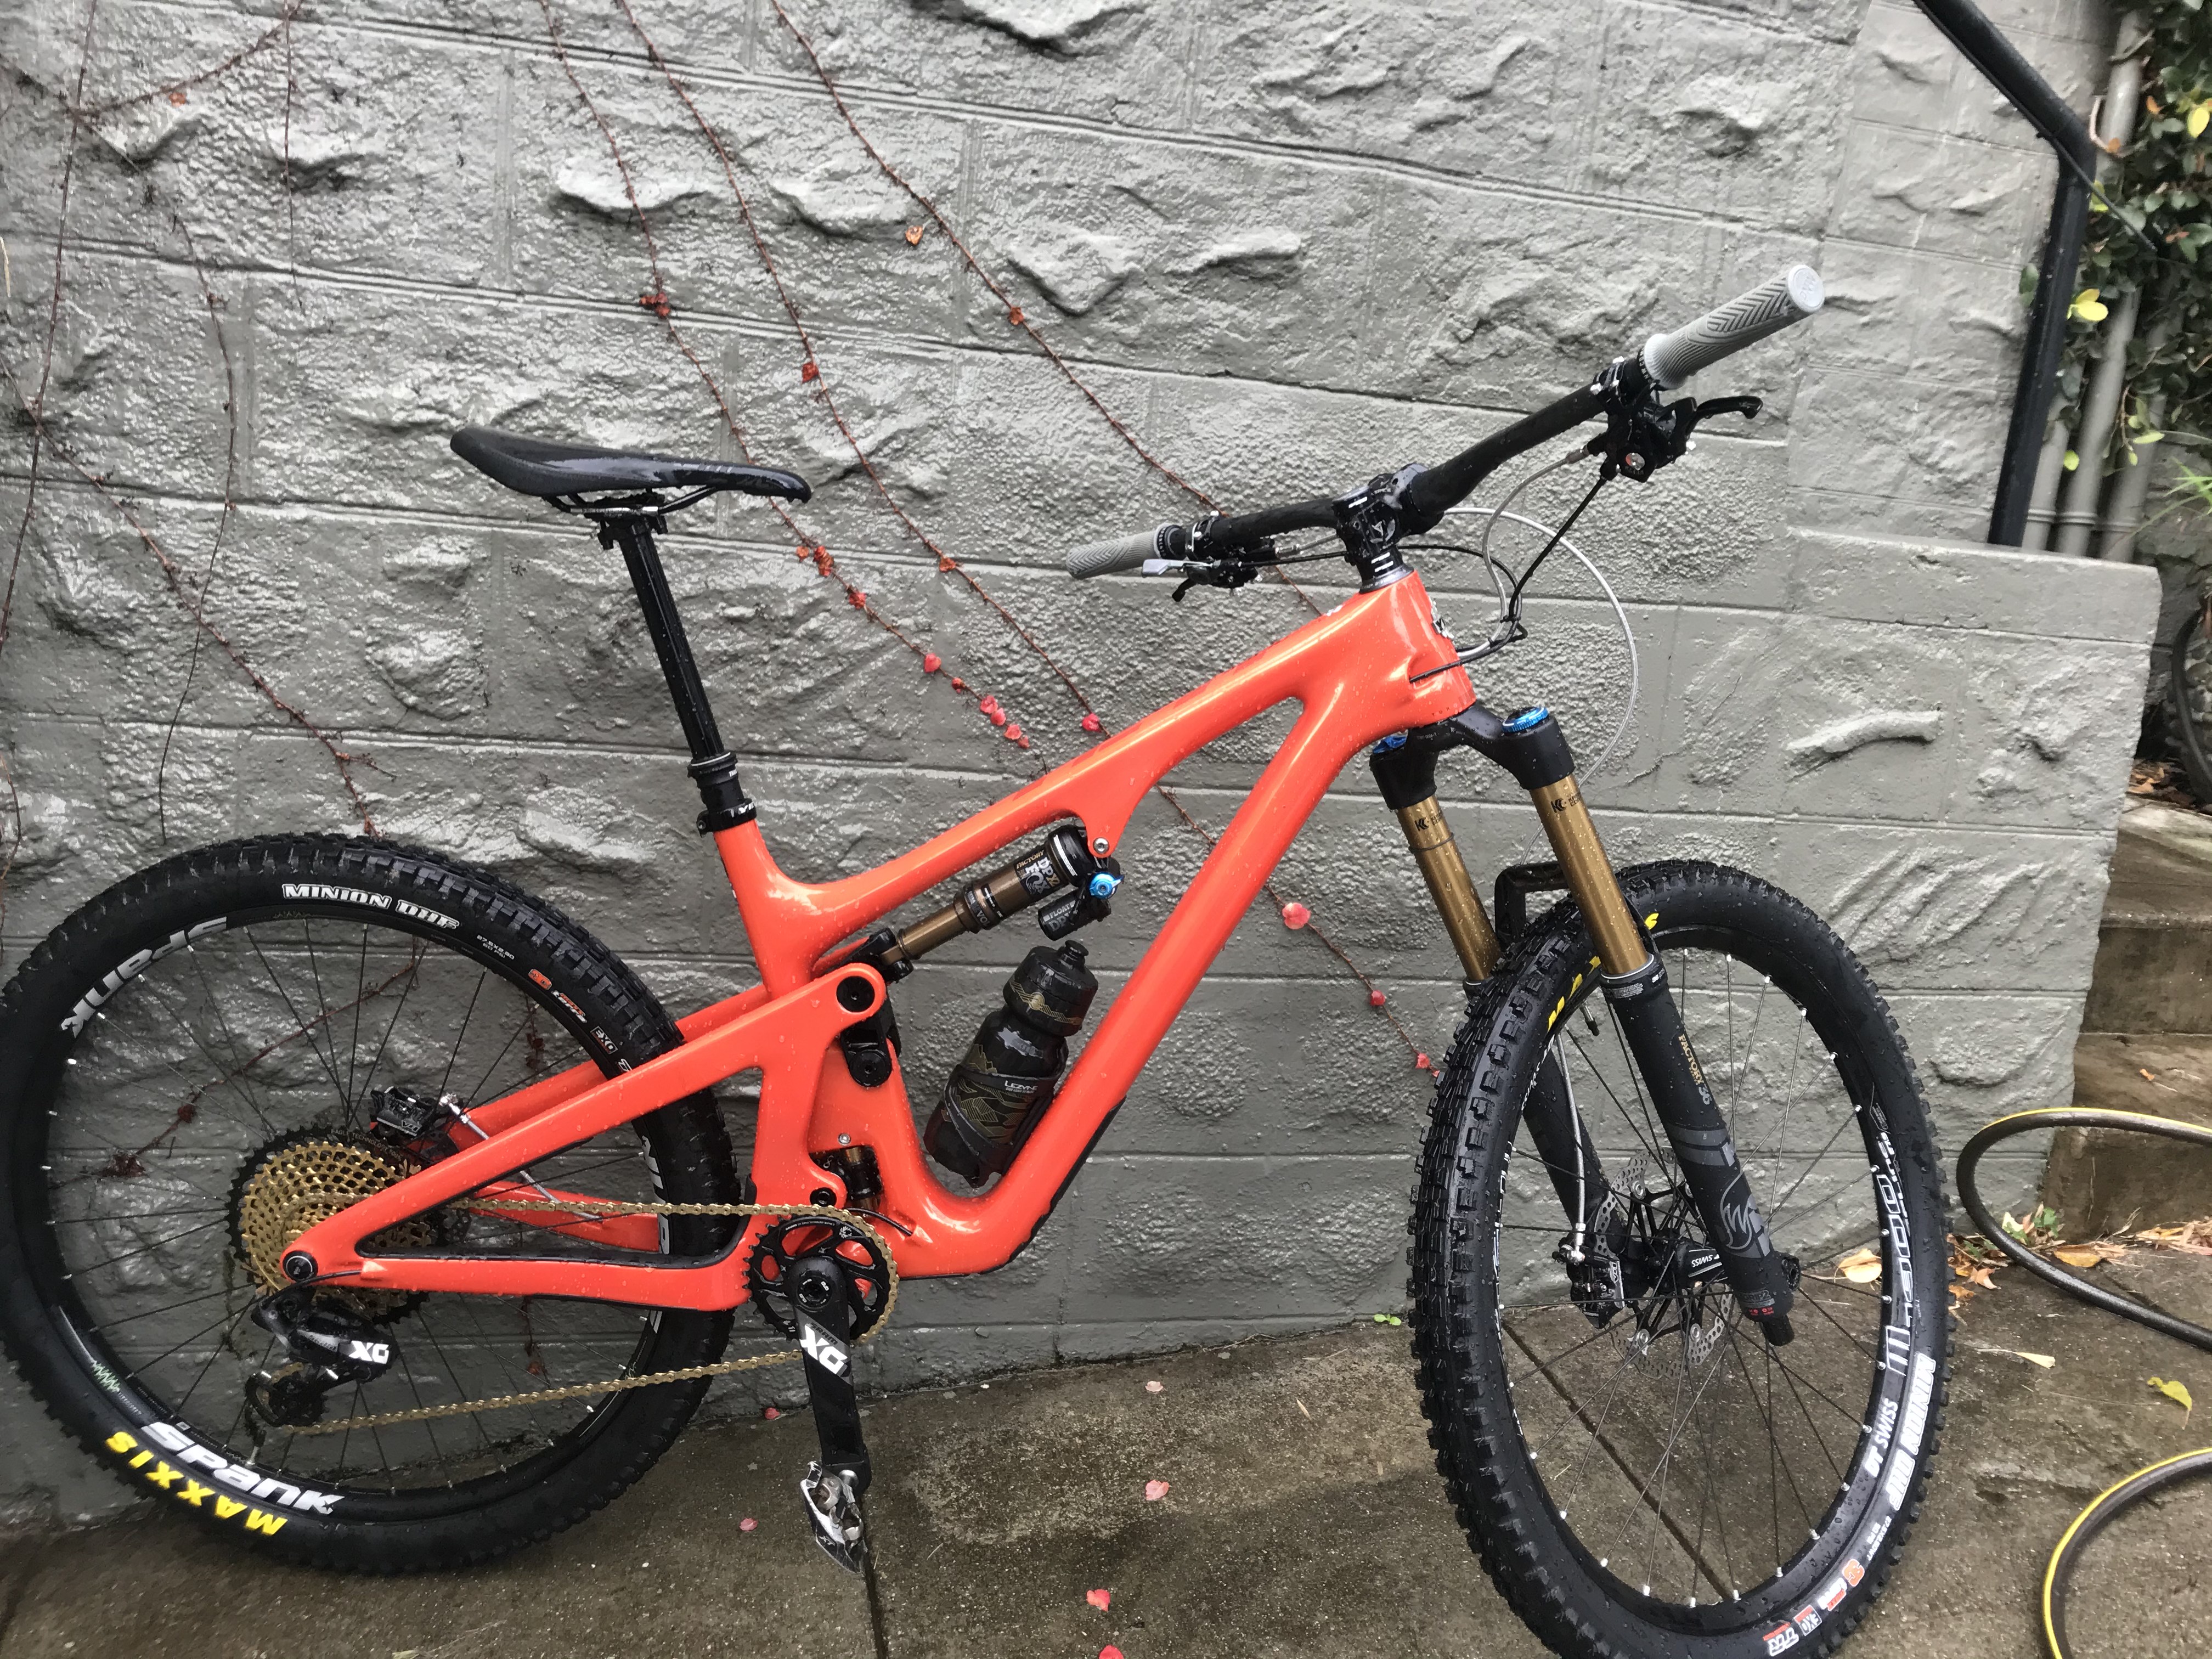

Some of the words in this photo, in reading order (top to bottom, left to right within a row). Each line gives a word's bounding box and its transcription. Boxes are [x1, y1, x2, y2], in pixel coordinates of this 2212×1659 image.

[282, 884, 392, 909] MINION
[396, 899, 460, 929] DHF
[1678, 1034, 1705, 1085] FACTORY
[1691, 1254, 1713, 1268] SWISS
[809, 1322, 839, 1345] SRAM
[1900, 1352, 1937, 1455] MINION
[1865, 1445, 1884, 1477] DT
[1875, 1398, 1898, 1449] SWISS
[105, 1430, 288, 1536] MAXXIS
[1886, 1448, 1916, 1511] DHF
[1768, 1626, 1799, 1657] TR
